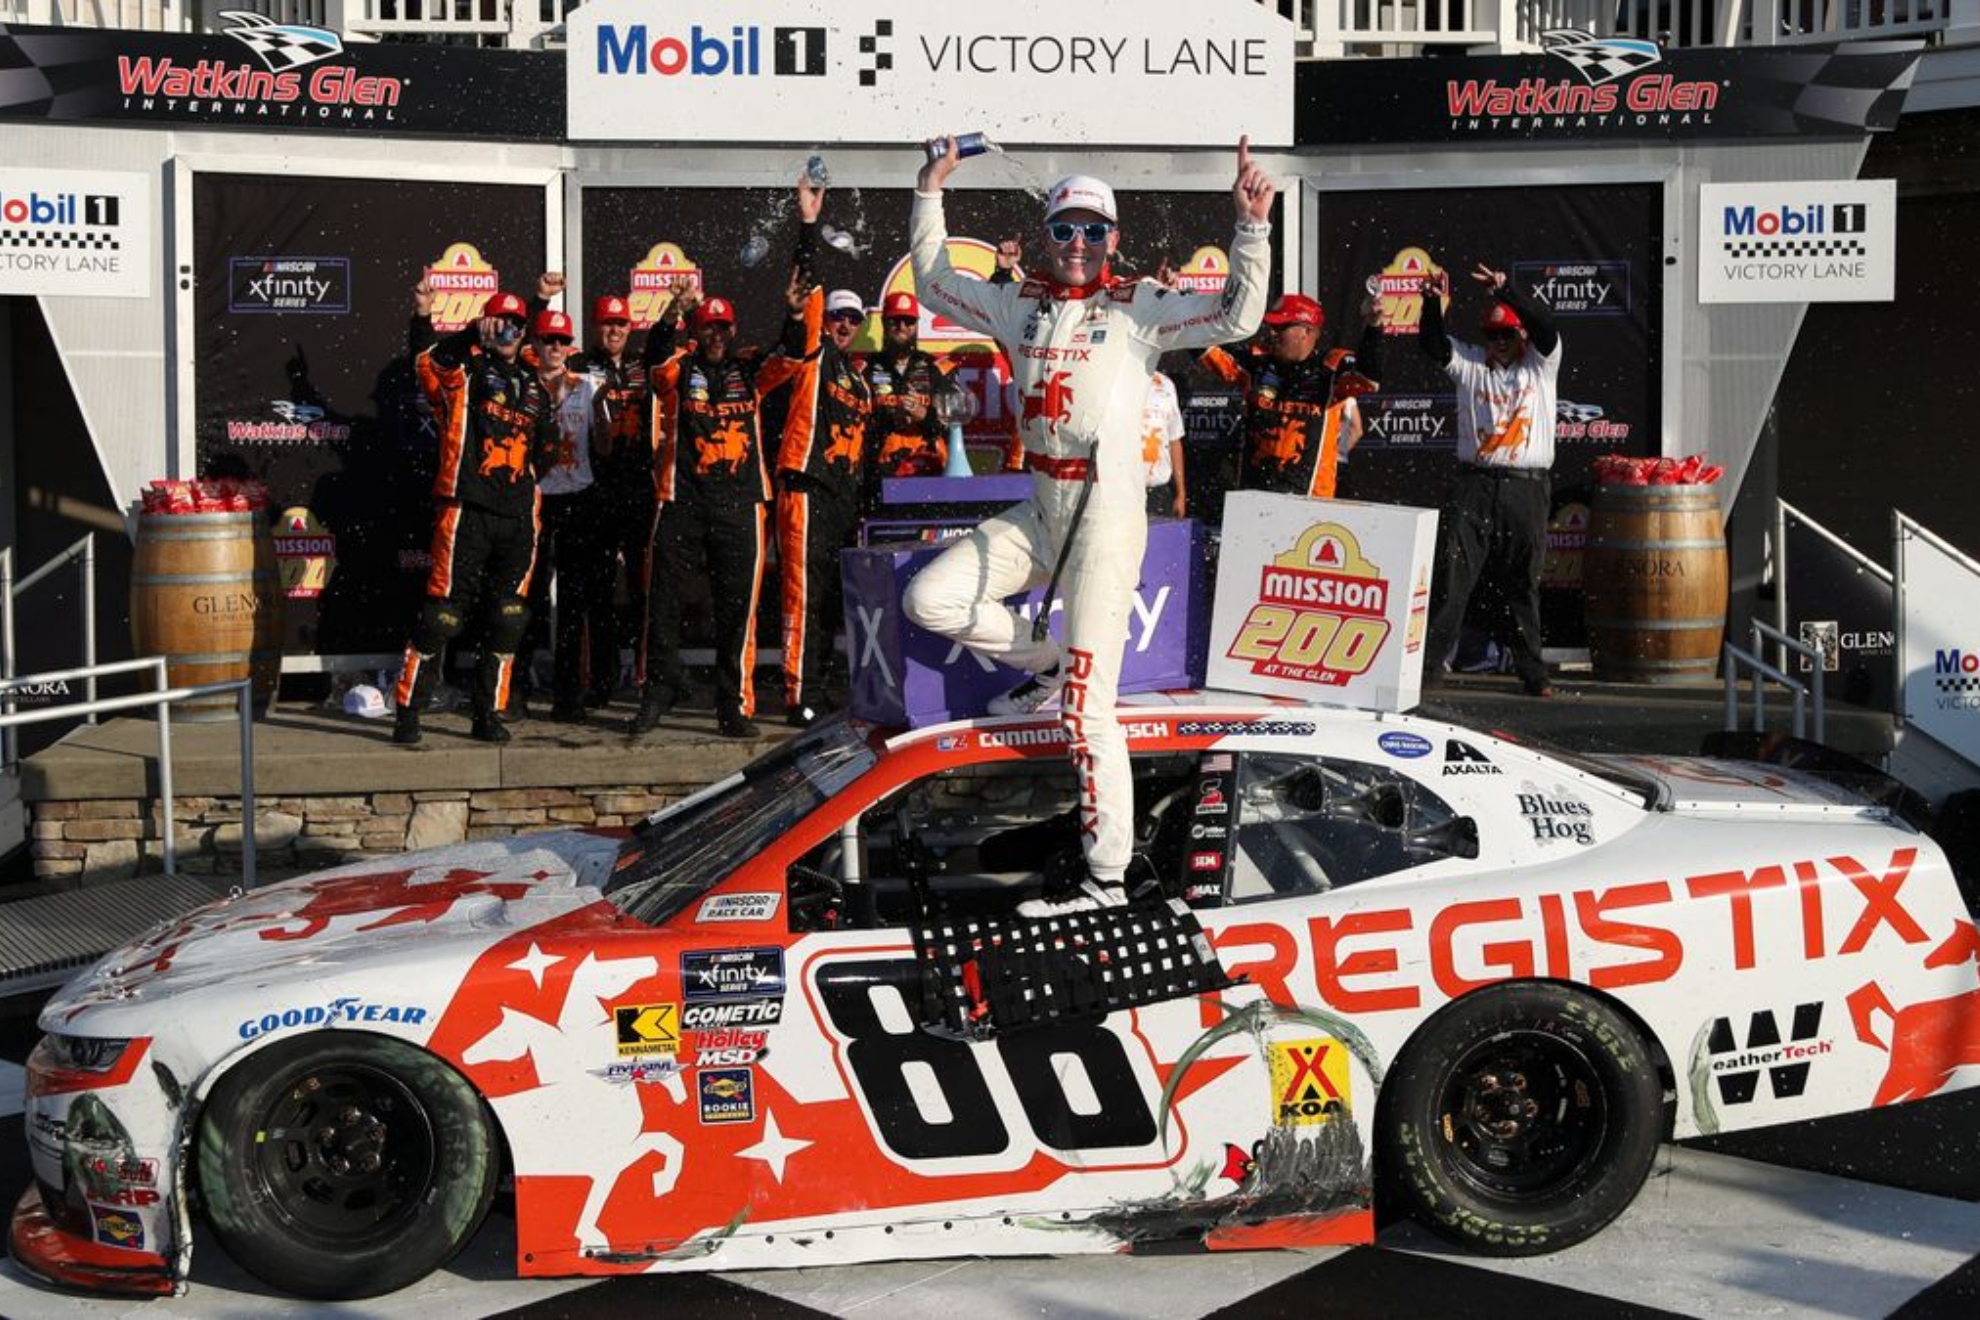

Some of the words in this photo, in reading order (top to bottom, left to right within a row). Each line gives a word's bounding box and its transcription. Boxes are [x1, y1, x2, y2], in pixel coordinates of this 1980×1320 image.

[597, 25, 759, 75] Mobil
[919, 34, 1127, 74] VICTORY
[1144, 38, 1267, 75] LANE
[117, 54, 300, 102] Watkins
[308, 65, 400, 106] Glen
[1447, 78, 1618, 117] Watkins
[1625, 73, 1718, 112] Glen
[123, 97, 397, 121] INTERNATIONAL
[1451, 112, 1713, 130] INTERNATIONAL
[0, 192, 76, 224] obil
[1723, 203, 1824, 236] Mobil
[0, 253, 60, 271] TORY
[66, 255, 121, 273] LANE
[1556, 265, 1599, 276] NASCAR
[1724, 264, 1808, 280] VICTORY
[1814, 262, 1866, 279] LANE
[248, 273, 332, 303] xfinity
[430, 273, 496, 290] MISSION
[1178, 277, 1229, 291] MISSI
[1531, 277, 1611, 304] xfinity
[1018, 344, 1092, 361] REGISTIX
[1392, 399, 1432, 409] NASCAR
[1183, 409, 1242, 436] finity
[1368, 411, 1446, 437] xfinity
[1264, 571, 1384, 611] MISSION
[192, 594, 257, 614] GLEN
[1227, 604, 1391, 675] 200
[1262, 664, 1279, 675] AT
[1281, 665, 1303, 678] THE
[1305, 668, 1337, 683] GLEN
[1936, 649, 1980, 674] Mo
[1442, 764, 1504, 777] AXALTA
[1516, 793, 1591, 818] Blues
[1531, 816, 1592, 845] Hog
[708, 907, 738, 918] RACE
[740, 907, 765, 918] CAR
[1200, 847, 1932, 1029] REGISTIX
[699, 963, 768, 989] xfinity
[684, 1000, 780, 1025] COMETIC
[697, 1028, 767, 1051] Holley
[696, 1050, 758, 1066] MSD
[814, 957, 1158, 1160] 88
[704, 1102, 750, 1114] ROOKIE
[1279, 1099, 1342, 1117] KOA
